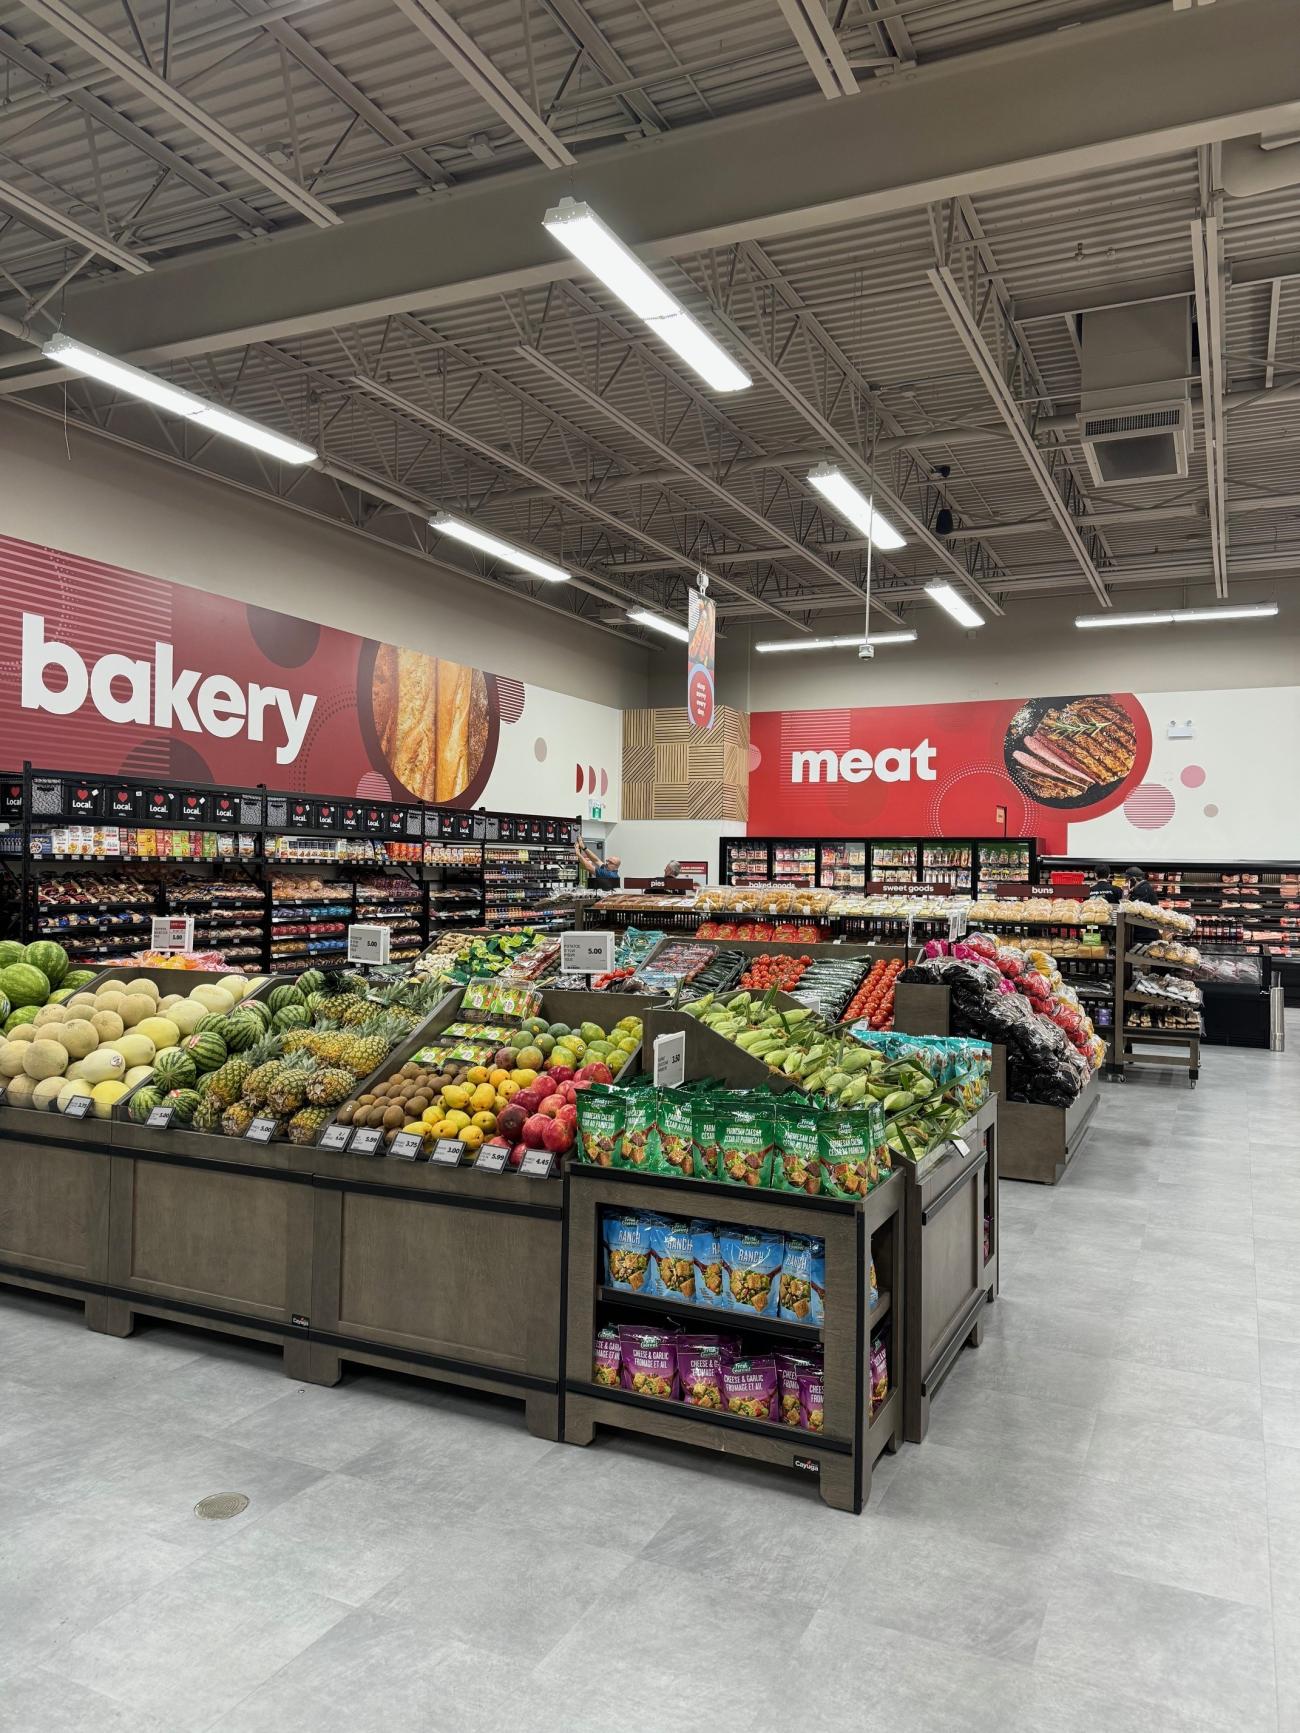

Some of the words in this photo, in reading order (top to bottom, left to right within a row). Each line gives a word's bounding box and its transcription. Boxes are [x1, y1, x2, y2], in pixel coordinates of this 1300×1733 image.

[21, 612, 318, 765] bakery
[791, 738, 937, 783] meat
[72, 799, 93, 810] Local.
[113, 802, 133, 812] Local.
[149, 804, 169, 815] Local.
[183, 806, 202, 816] Local.
[216, 808, 234, 818] Local.
[650, 880, 665, 888] pies
[748, 881, 771, 889] baked
[908, 885, 934, 893] goods
[1031, 886, 1054, 894] buns
[491, 1153, 505, 1161] 5.99
[535, 1158, 550, 1166] 4.45
[618, 1230, 641, 1245] RANCH
[667, 1236, 693, 1251] RANCH
[738, 1248, 764, 1263] RANCH
[786, 1254, 807, 1271] RANCH
[632, 1349, 648, 1360] CHEESE
[652, 1351, 669, 1361] GARLIC
[634, 1358, 653, 1368] FROMAGE
[691, 1360, 708, 1368] CHEESE
[692, 1368, 715, 1377] FROMAGE
[723, 1374, 741, 1384] CHEESE
[746, 1374, 764, 1383] GARLIC
[725, 1383, 748, 1392] FROMAGE
[795, 1460, 819, 1472] Cayuga
